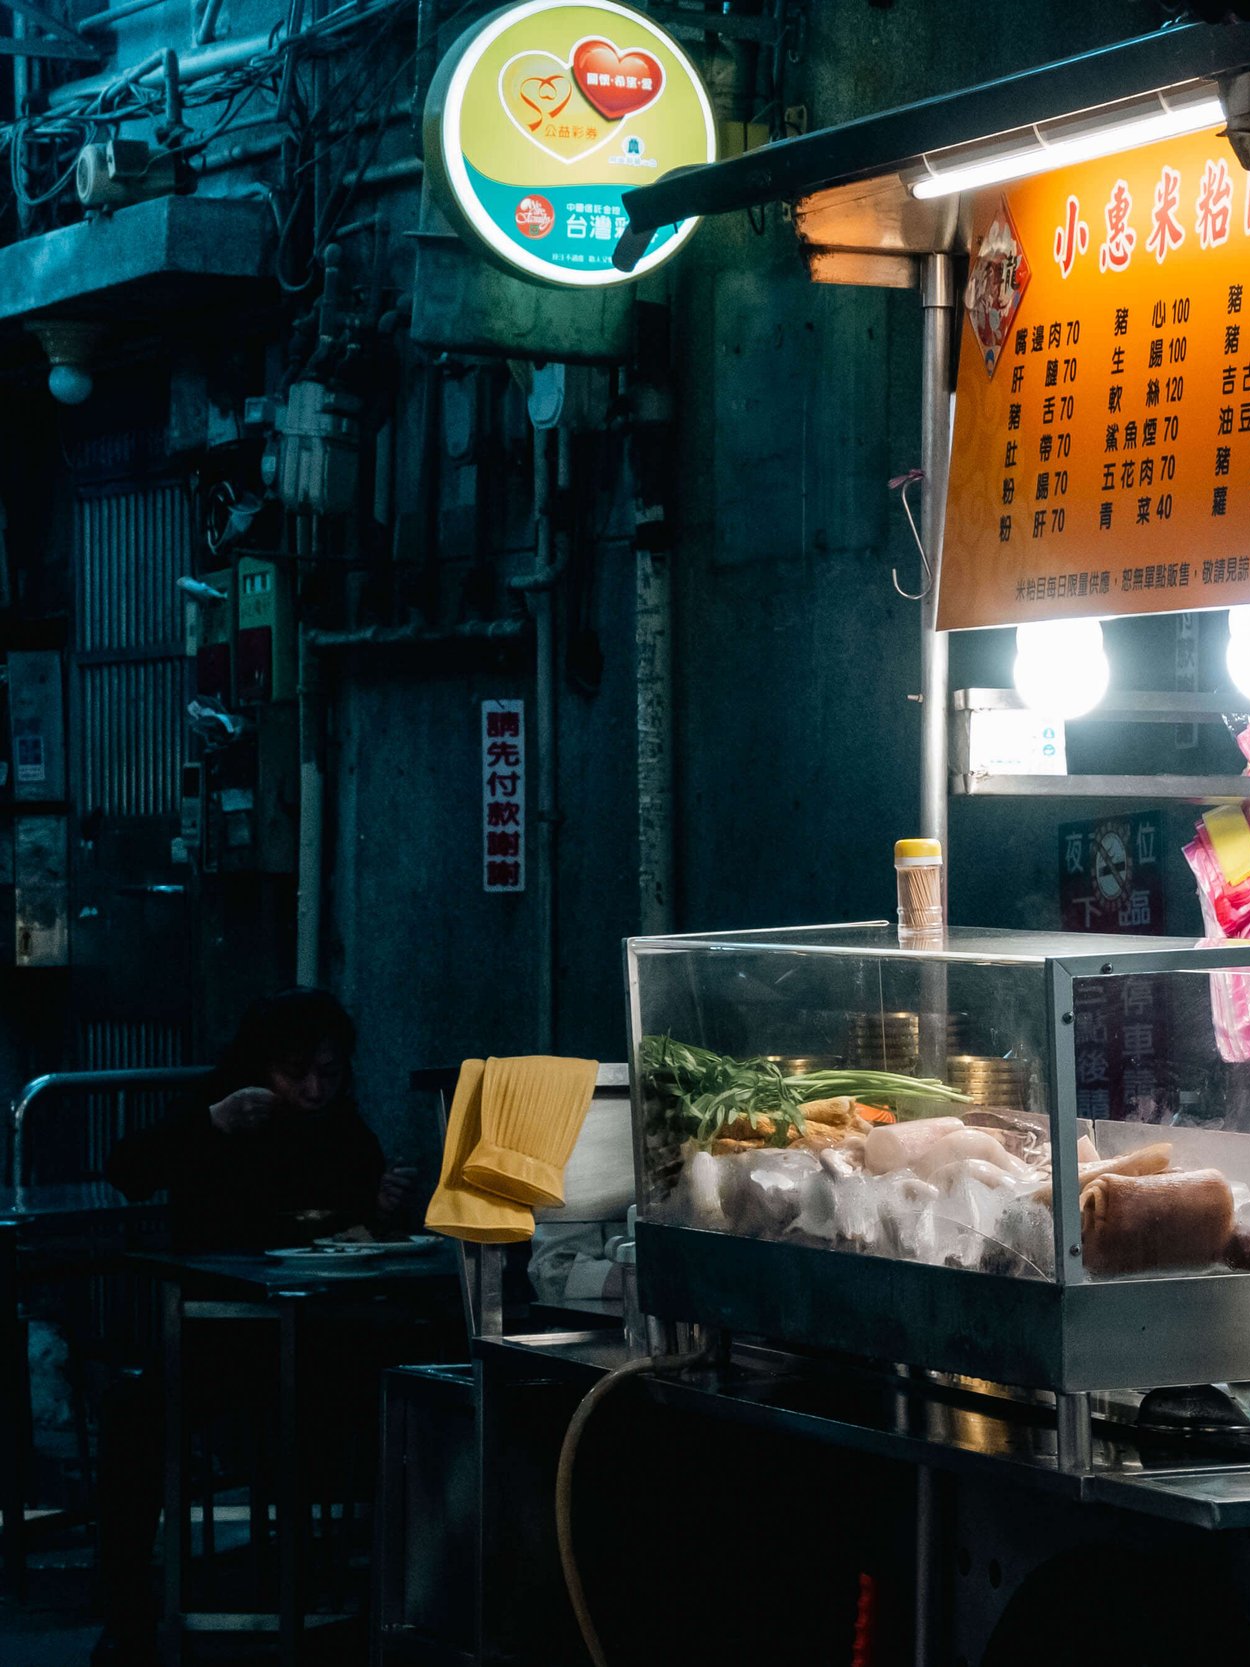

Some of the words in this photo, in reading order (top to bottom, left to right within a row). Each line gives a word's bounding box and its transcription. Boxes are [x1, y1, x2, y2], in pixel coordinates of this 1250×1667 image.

[545, 124, 597, 139] 公益彩券
[1172, 297, 1190, 324] 100
[1015, 322, 1061, 355] 嘴邊肉
[1066, 320, 1080, 346] 70
[1168, 337, 1187, 364] 100
[1063, 358, 1077, 383] 70
[1165, 376, 1184, 403] 120
[1060, 395, 1074, 421] 70
[1057, 433, 1071, 458] 70
[1104, 418, 1157, 453] 鯊魚煙
[1163, 415, 1179, 442] 70
[1054, 470, 1068, 497] 70
[1101, 457, 1153, 491] 五花肉
[1160, 454, 1175, 481] 70
[1156, 494, 1172, 520] 40
[1051, 508, 1065, 534] 70
[487, 711, 520, 886] 請先付款謝謝
